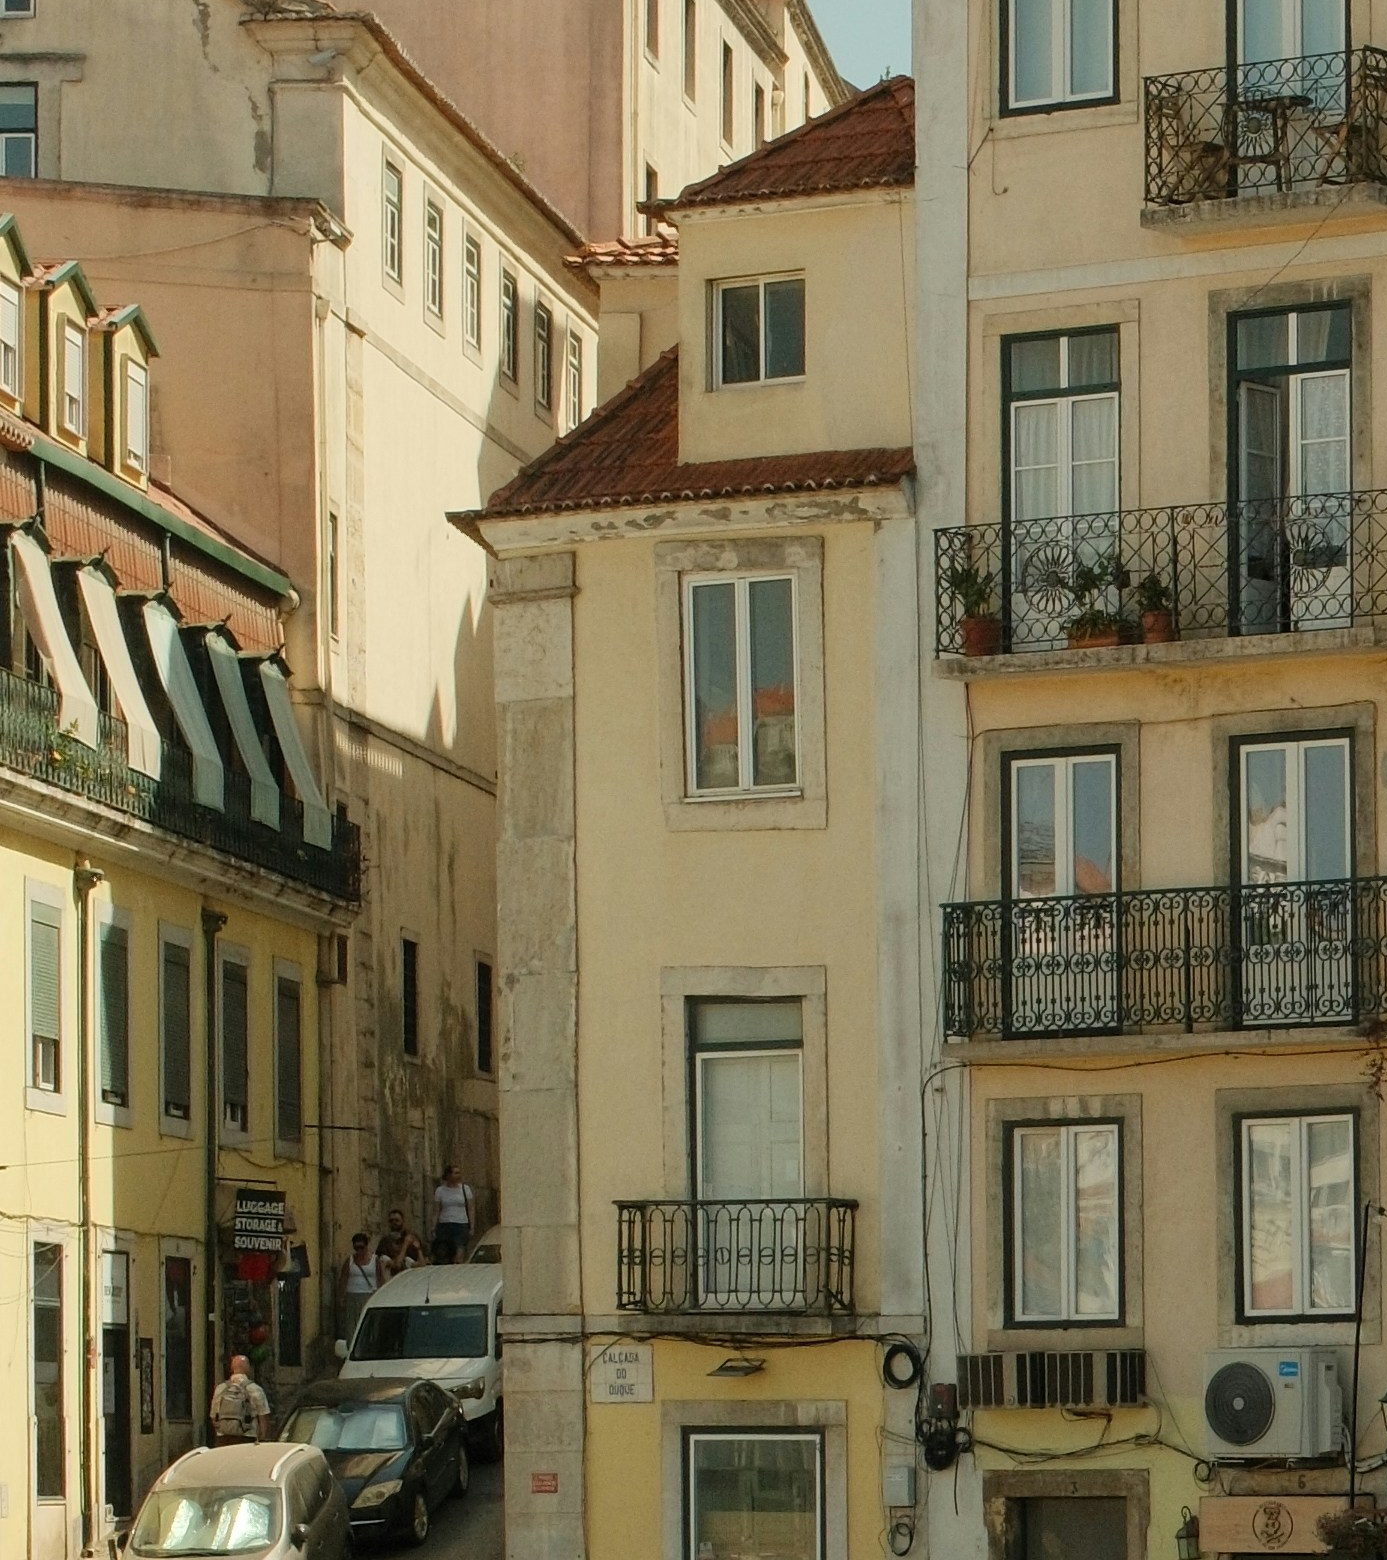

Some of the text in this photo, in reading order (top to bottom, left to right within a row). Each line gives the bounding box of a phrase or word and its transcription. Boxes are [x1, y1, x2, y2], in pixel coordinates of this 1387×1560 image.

[236, 1200, 285, 1215] LUGGAGE
[235, 1217, 277, 1232] STORAGE
[234, 1236, 282, 1251] SOUVENIR
[616, 1368, 627, 1380] DO
